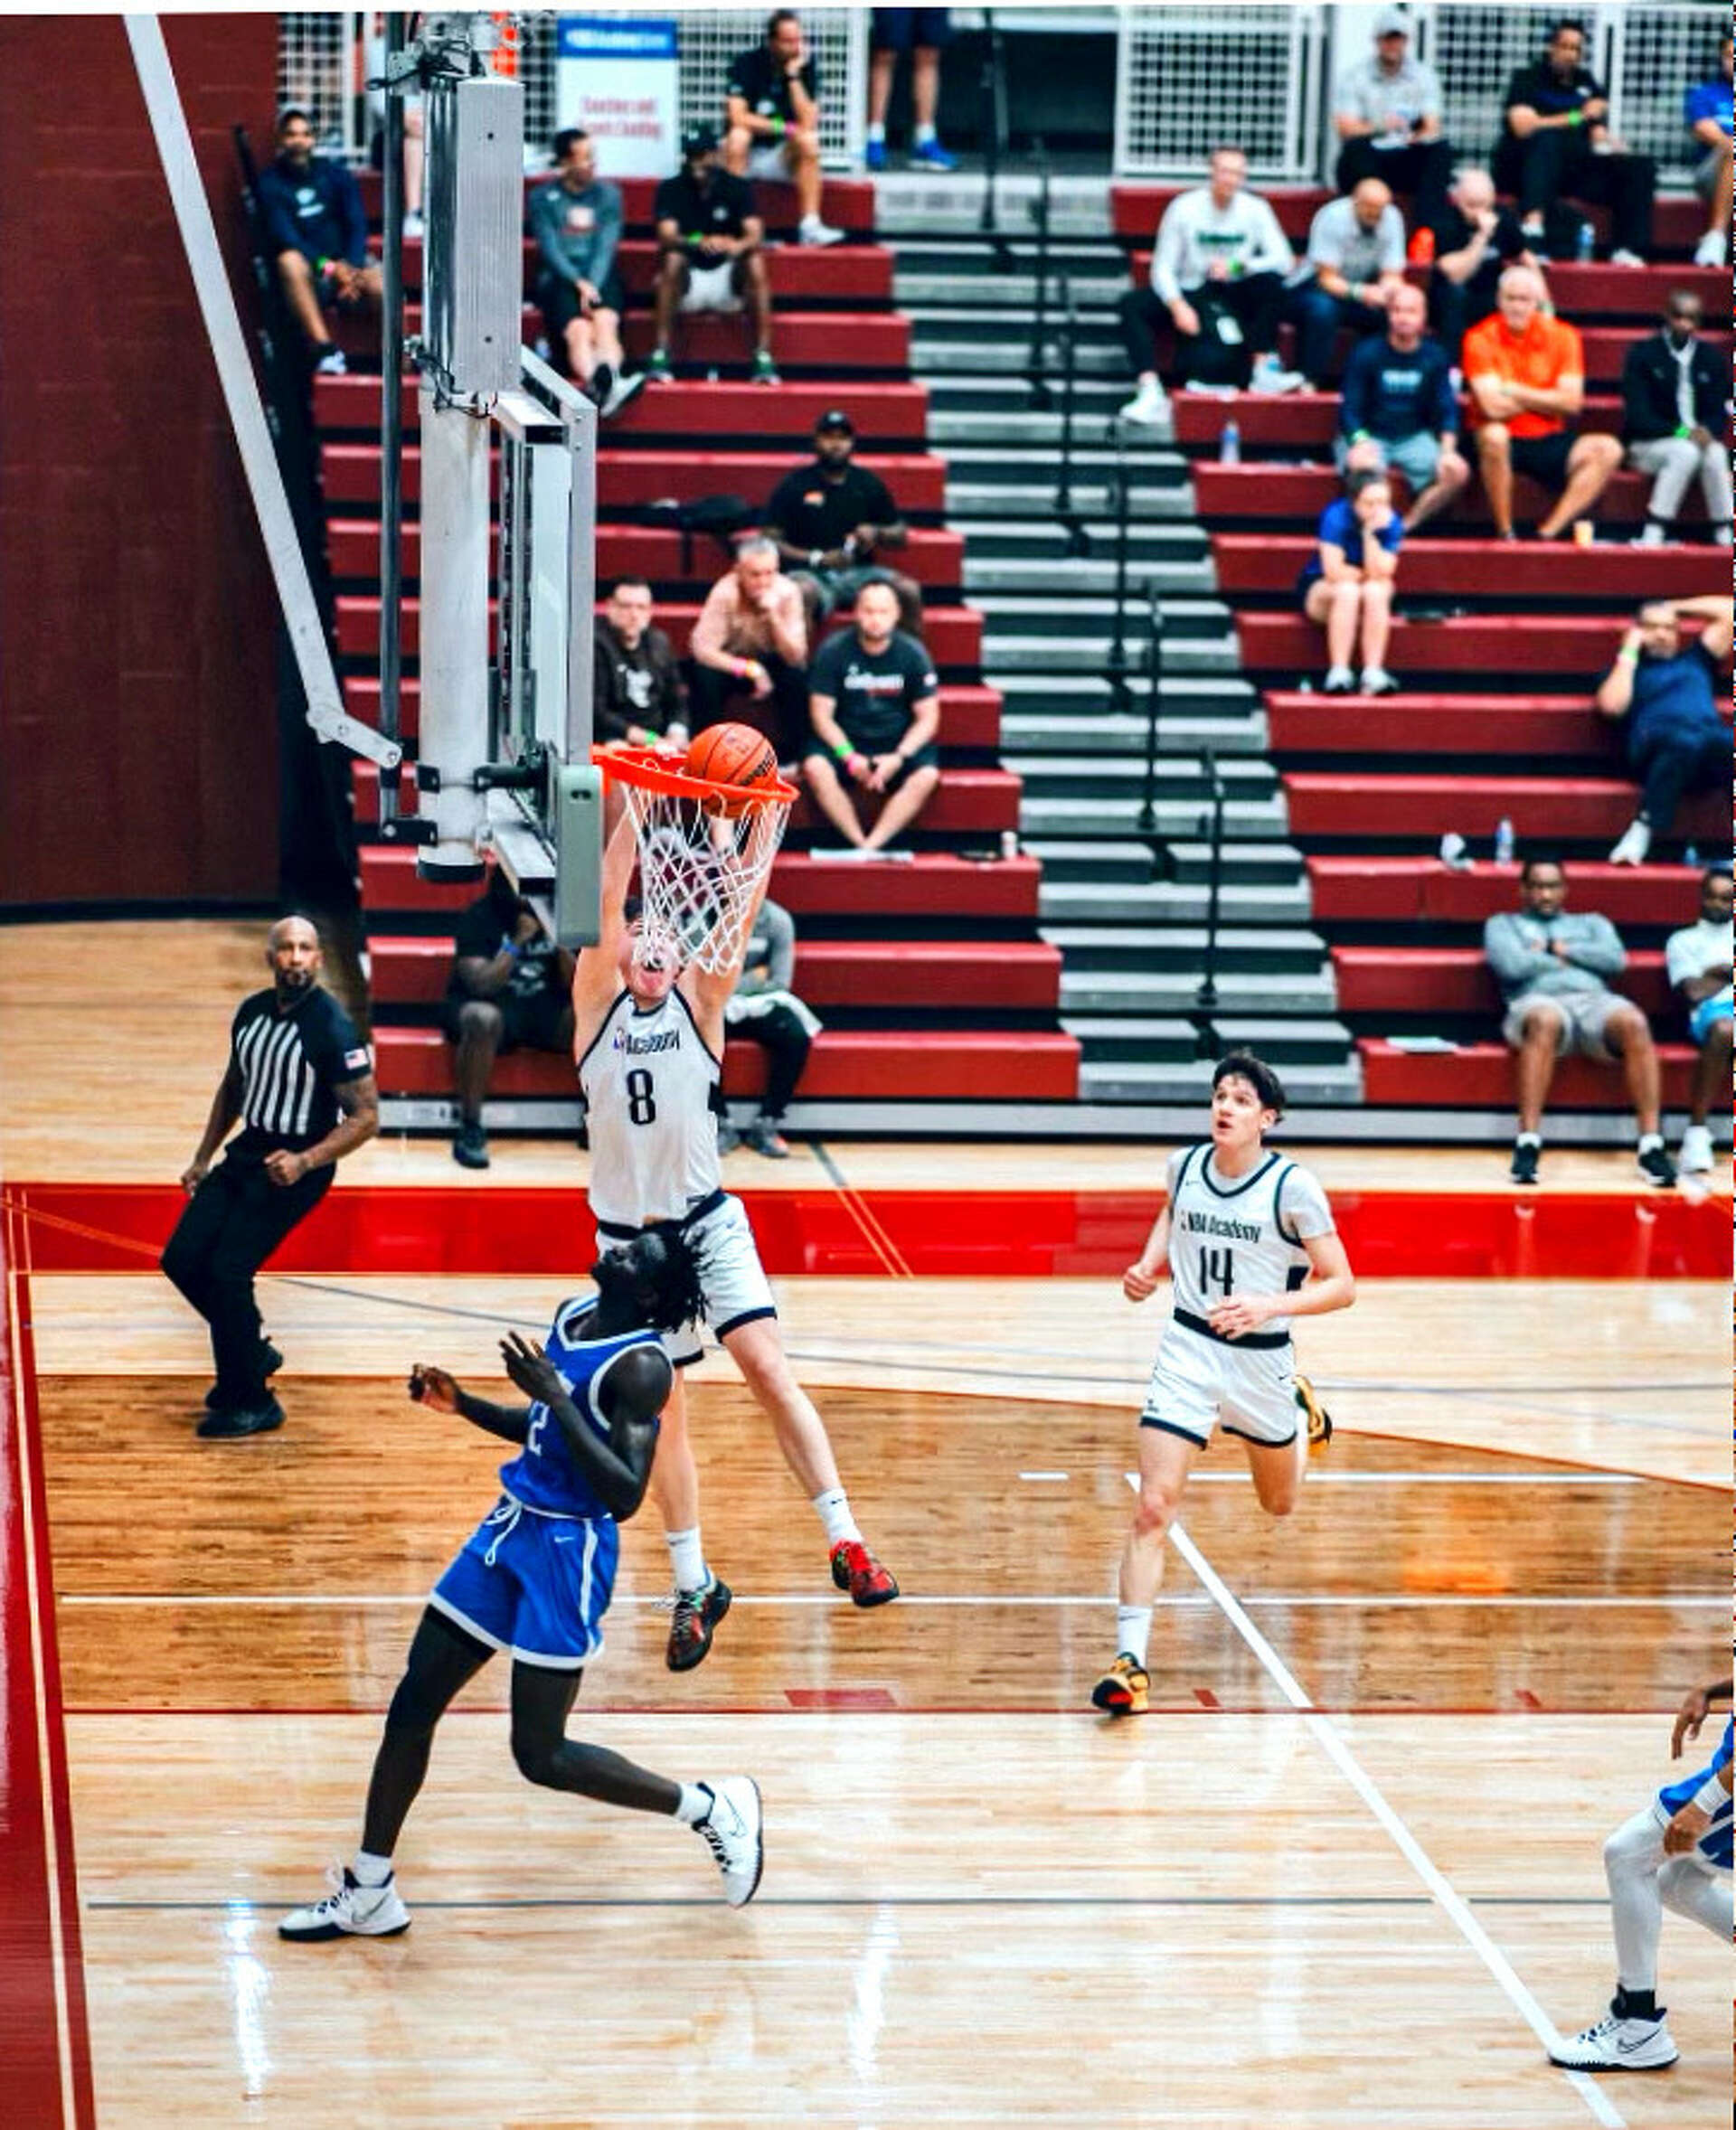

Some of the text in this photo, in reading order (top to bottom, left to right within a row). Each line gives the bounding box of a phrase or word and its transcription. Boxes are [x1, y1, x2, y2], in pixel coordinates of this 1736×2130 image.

[627, 1068, 656, 1125] 8
[1188, 1211, 1207, 1233] NBA
[1208, 1215, 1261, 1243] Academy
[1200, 1245, 1234, 1296] 14
